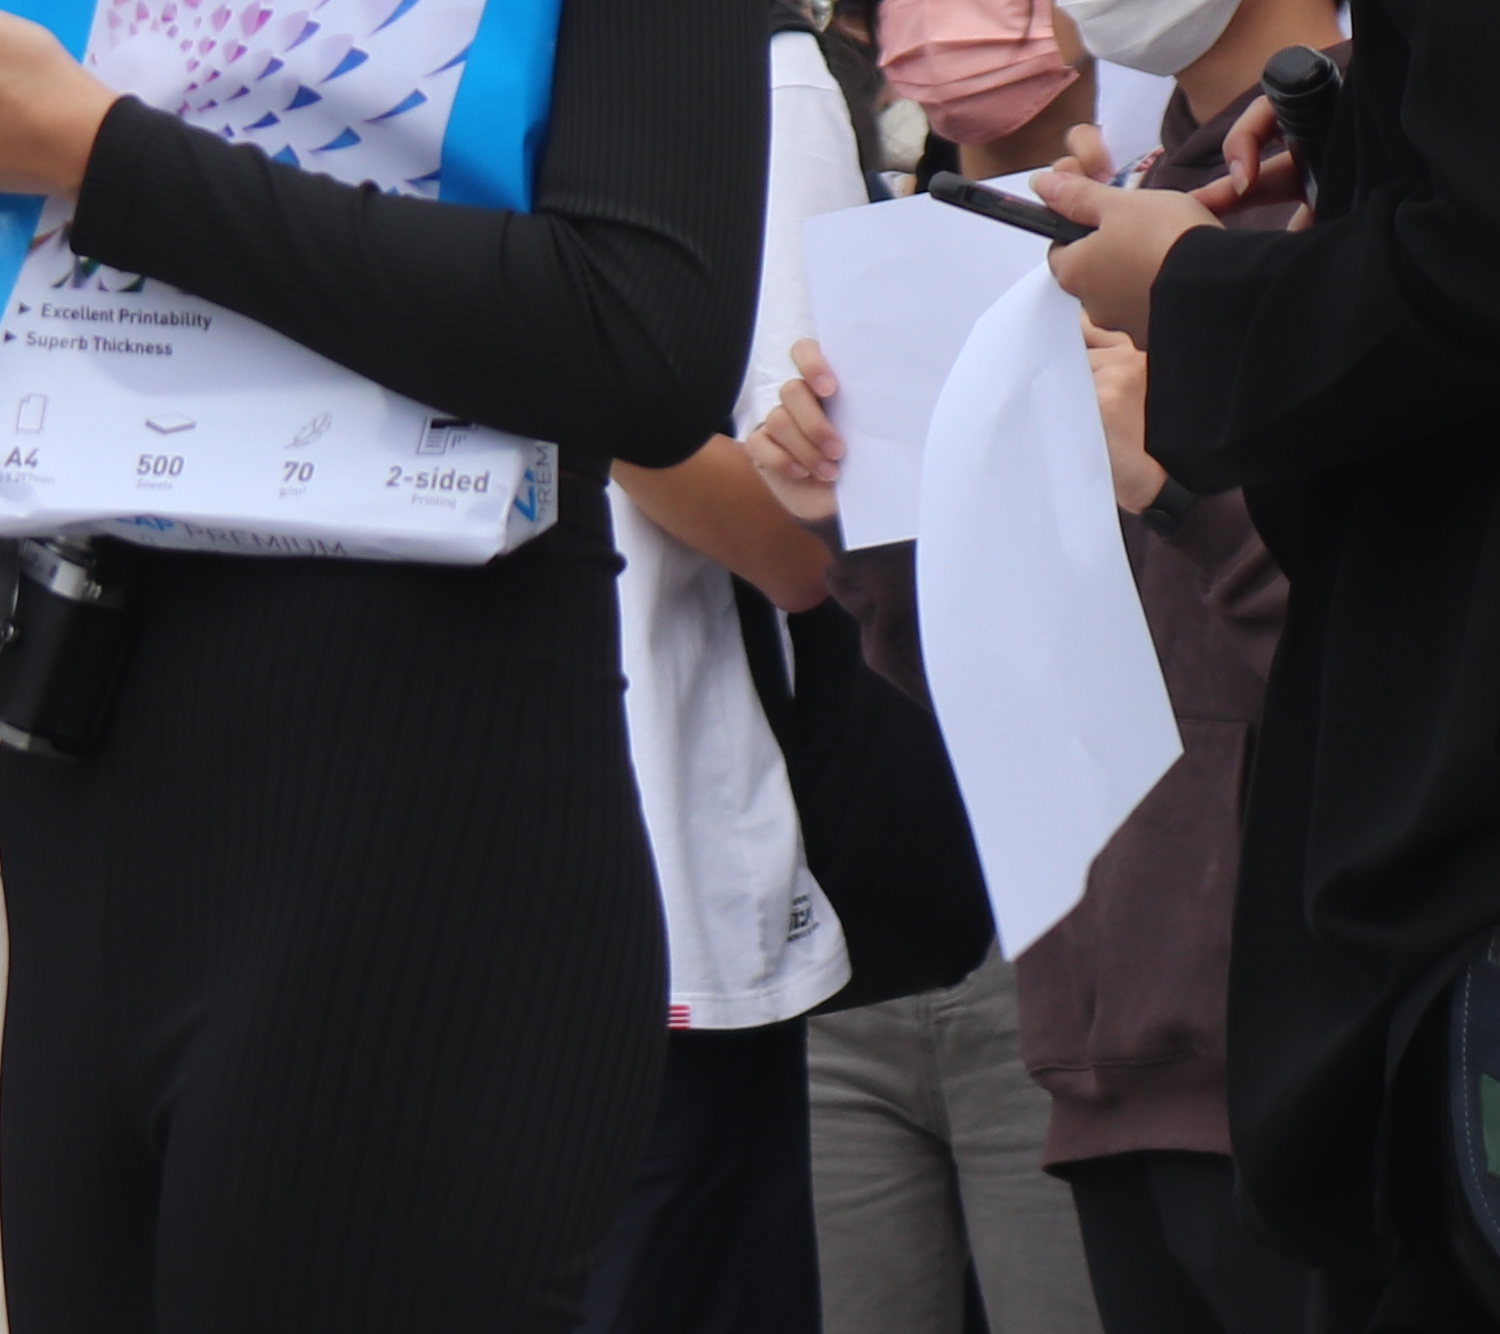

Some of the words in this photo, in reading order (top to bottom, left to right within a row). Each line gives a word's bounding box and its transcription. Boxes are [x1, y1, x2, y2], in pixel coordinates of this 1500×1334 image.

[41, 303, 114, 323] Excellent
[119, 309, 213, 331] Printability
[27, 331, 88, 353] Superb
[94, 336, 172, 355] Thickness
[4, 446, 39, 467] A4
[137, 454, 184, 476] 500
[283, 461, 315, 482] 70
[386, 466, 490, 494] 2-sided
